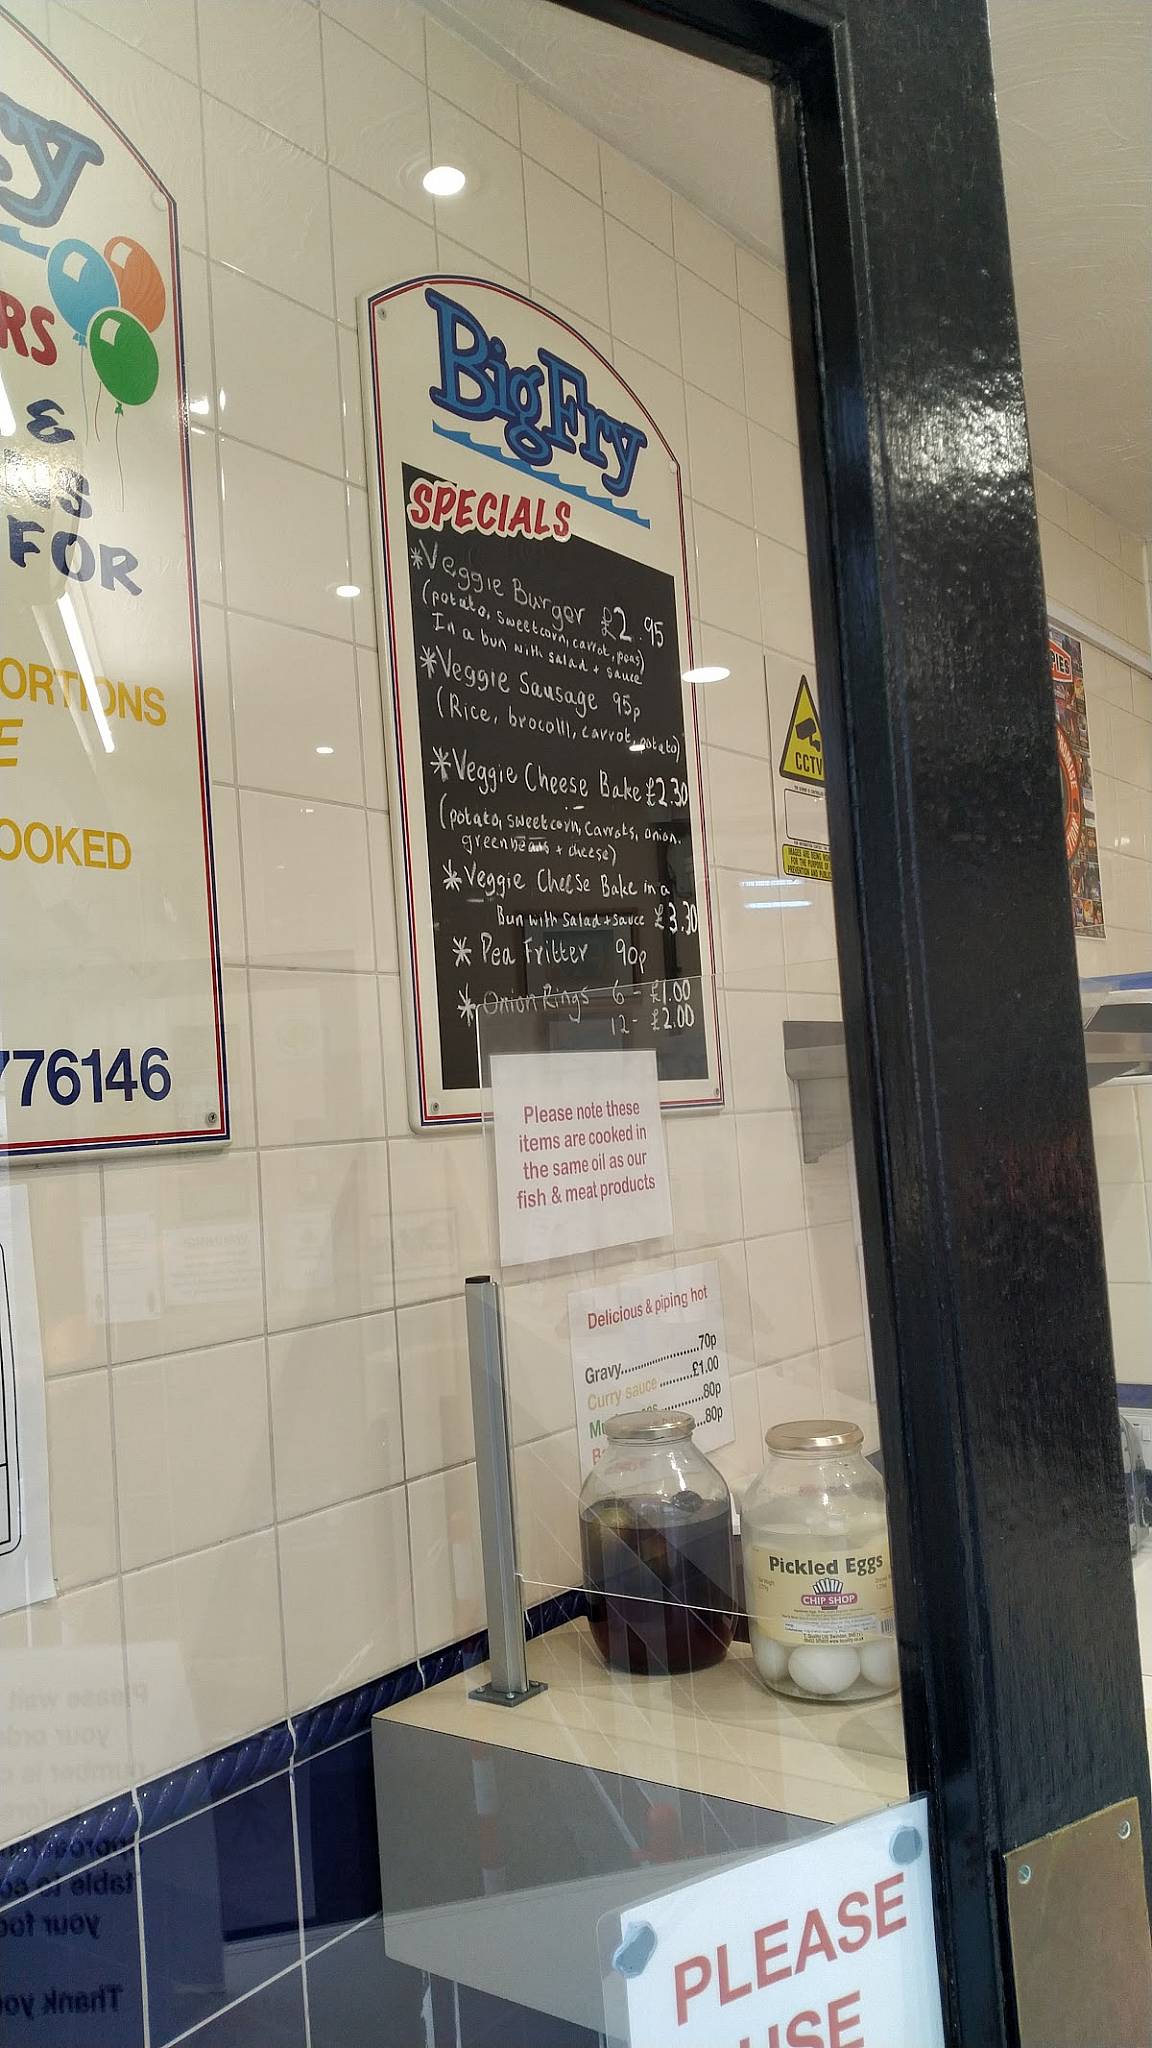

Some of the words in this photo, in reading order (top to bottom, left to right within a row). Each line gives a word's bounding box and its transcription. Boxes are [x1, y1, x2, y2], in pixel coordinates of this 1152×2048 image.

[410, 482, 571, 538] SPECIALS
[7, 514, 143, 597] FOR
[418, 538, 504, 597] Veggie
[511, 577, 586, 632] Burger
[431, 611, 456, 636] In
[462, 627, 475, 641] a
[480, 627, 507, 652] bun
[548, 651, 589, 673] salad
[606, 666, 643, 685] sauce
[435, 644, 511, 694] Veggie
[519, 671, 599, 719] Sausage
[612, 691, 641, 723] 95p
[452, 747, 518, 795] Veggie
[523, 762, 589, 798] Cheese
[599, 769, 642, 802] Bake
[645, 776, 689, 808] £2.30
[795, 751, 823, 776] CCTV
[464, 860, 526, 899] Veggie
[537, 868, 592, 895] Cheese
[600, 873, 638, 898] Bake
[643, 879, 657, 895] in
[660, 885, 671, 898] a
[496, 904, 524, 928] Bun
[528, 909, 557, 928] with
[653, 900, 699, 935] £3.30
[480, 931, 516, 966] Pea
[522, 936, 589, 966] Fritter
[615, 938, 648, 974] 90p
[482, 988, 538, 1015] Onion
[542, 982, 590, 1024] Rings
[611, 979, 625, 1005] 6
[649, 979, 691, 1005] £1.00
[610, 1013, 630, 1036] 12
[650, 1003, 696, 1031] £2.00
[523, 1104, 574, 1125] Please
[576, 1101, 603, 1121] note
[606, 1099, 641, 1118] these
[519, 1133, 562, 1153] items
[564, 1134, 587, 1149] are
[588, 1124, 634, 1146] cooked
[635, 1123, 648, 1141] in
[523, 1160, 549, 1180] the
[552, 1159, 590, 1177] same
[591, 1152, 607, 1172] oil
[609, 1155, 625, 1170] as
[627, 1151, 648, 1168] our
[516, 1187, 547, 1210] fish
[551, 1185, 563, 1205] &
[565, 1181, 599, 1203] meat
[600, 1173, 656, 1202] products
[587, 1303, 643, 1330] Delicious
[645, 1298, 654, 1315] &
[655, 1291, 689, 1316] piping
[690, 1284, 709, 1303] hot
[587, 1389, 623, 1412] Curry
[625, 1376, 659, 1399] sauce
[768, 1555, 839, 1576] Pickled
[845, 1554, 884, 1577] Eggs
[802, 1596, 827, 1606] CHIP
[828, 1594, 855, 1605] SHOP
[674, 1872, 907, 2027] PLEASE
[739, 1990, 865, 2048] SE
